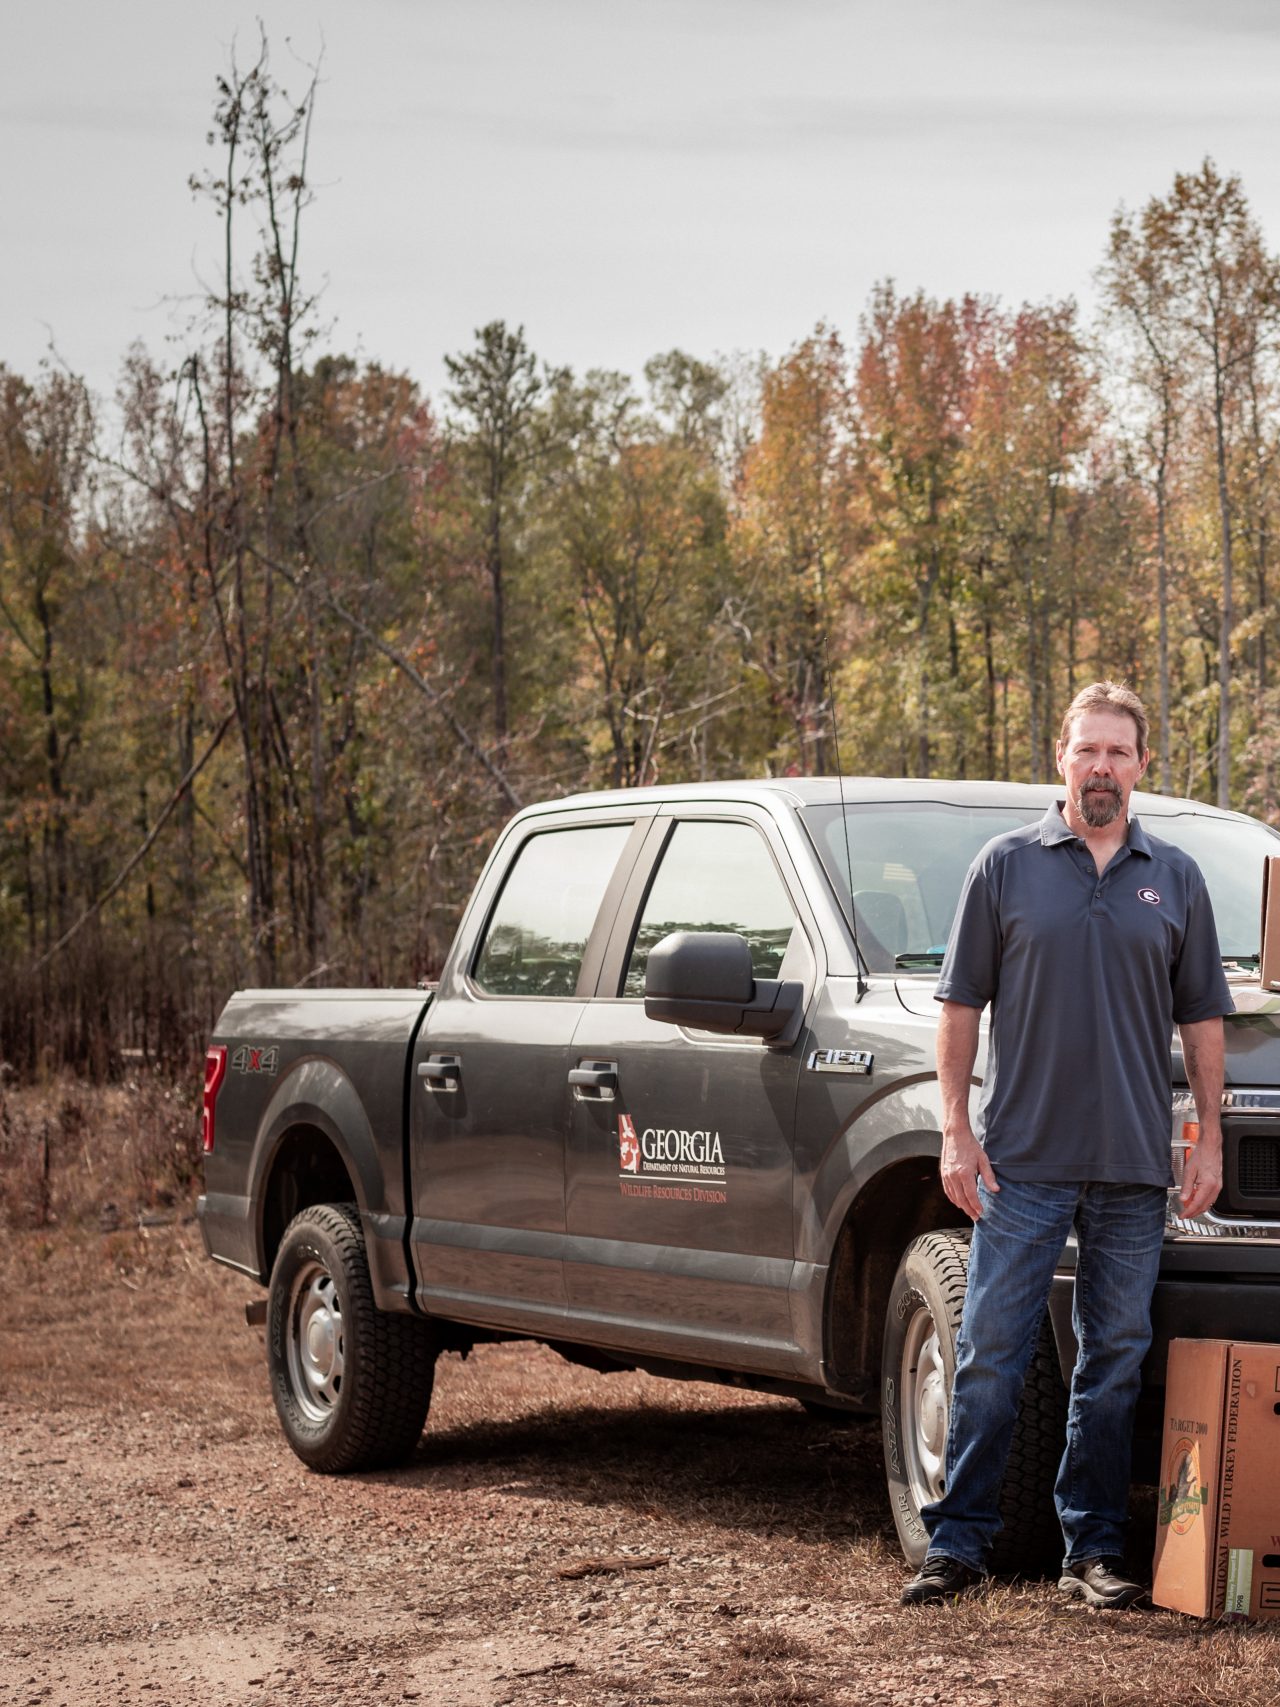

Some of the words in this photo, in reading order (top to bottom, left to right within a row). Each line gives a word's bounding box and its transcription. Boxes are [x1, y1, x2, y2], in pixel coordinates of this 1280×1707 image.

[642, 1129, 725, 1163] GEORGIA
[620, 1183, 652, 1198] WILDLIFE
[653, 1185, 693, 1201] RESOURCES
[694, 1187, 727, 1204] DIVISION
[1228, 1359, 1242, 1443] FEDERATION
[1170, 1418, 1195, 1435] TARGET
[1223, 1446, 1236, 1499] TURKEY
[1221, 1503, 1231, 1538] WILD
[1215, 1542, 1229, 1610] NATIONAL
